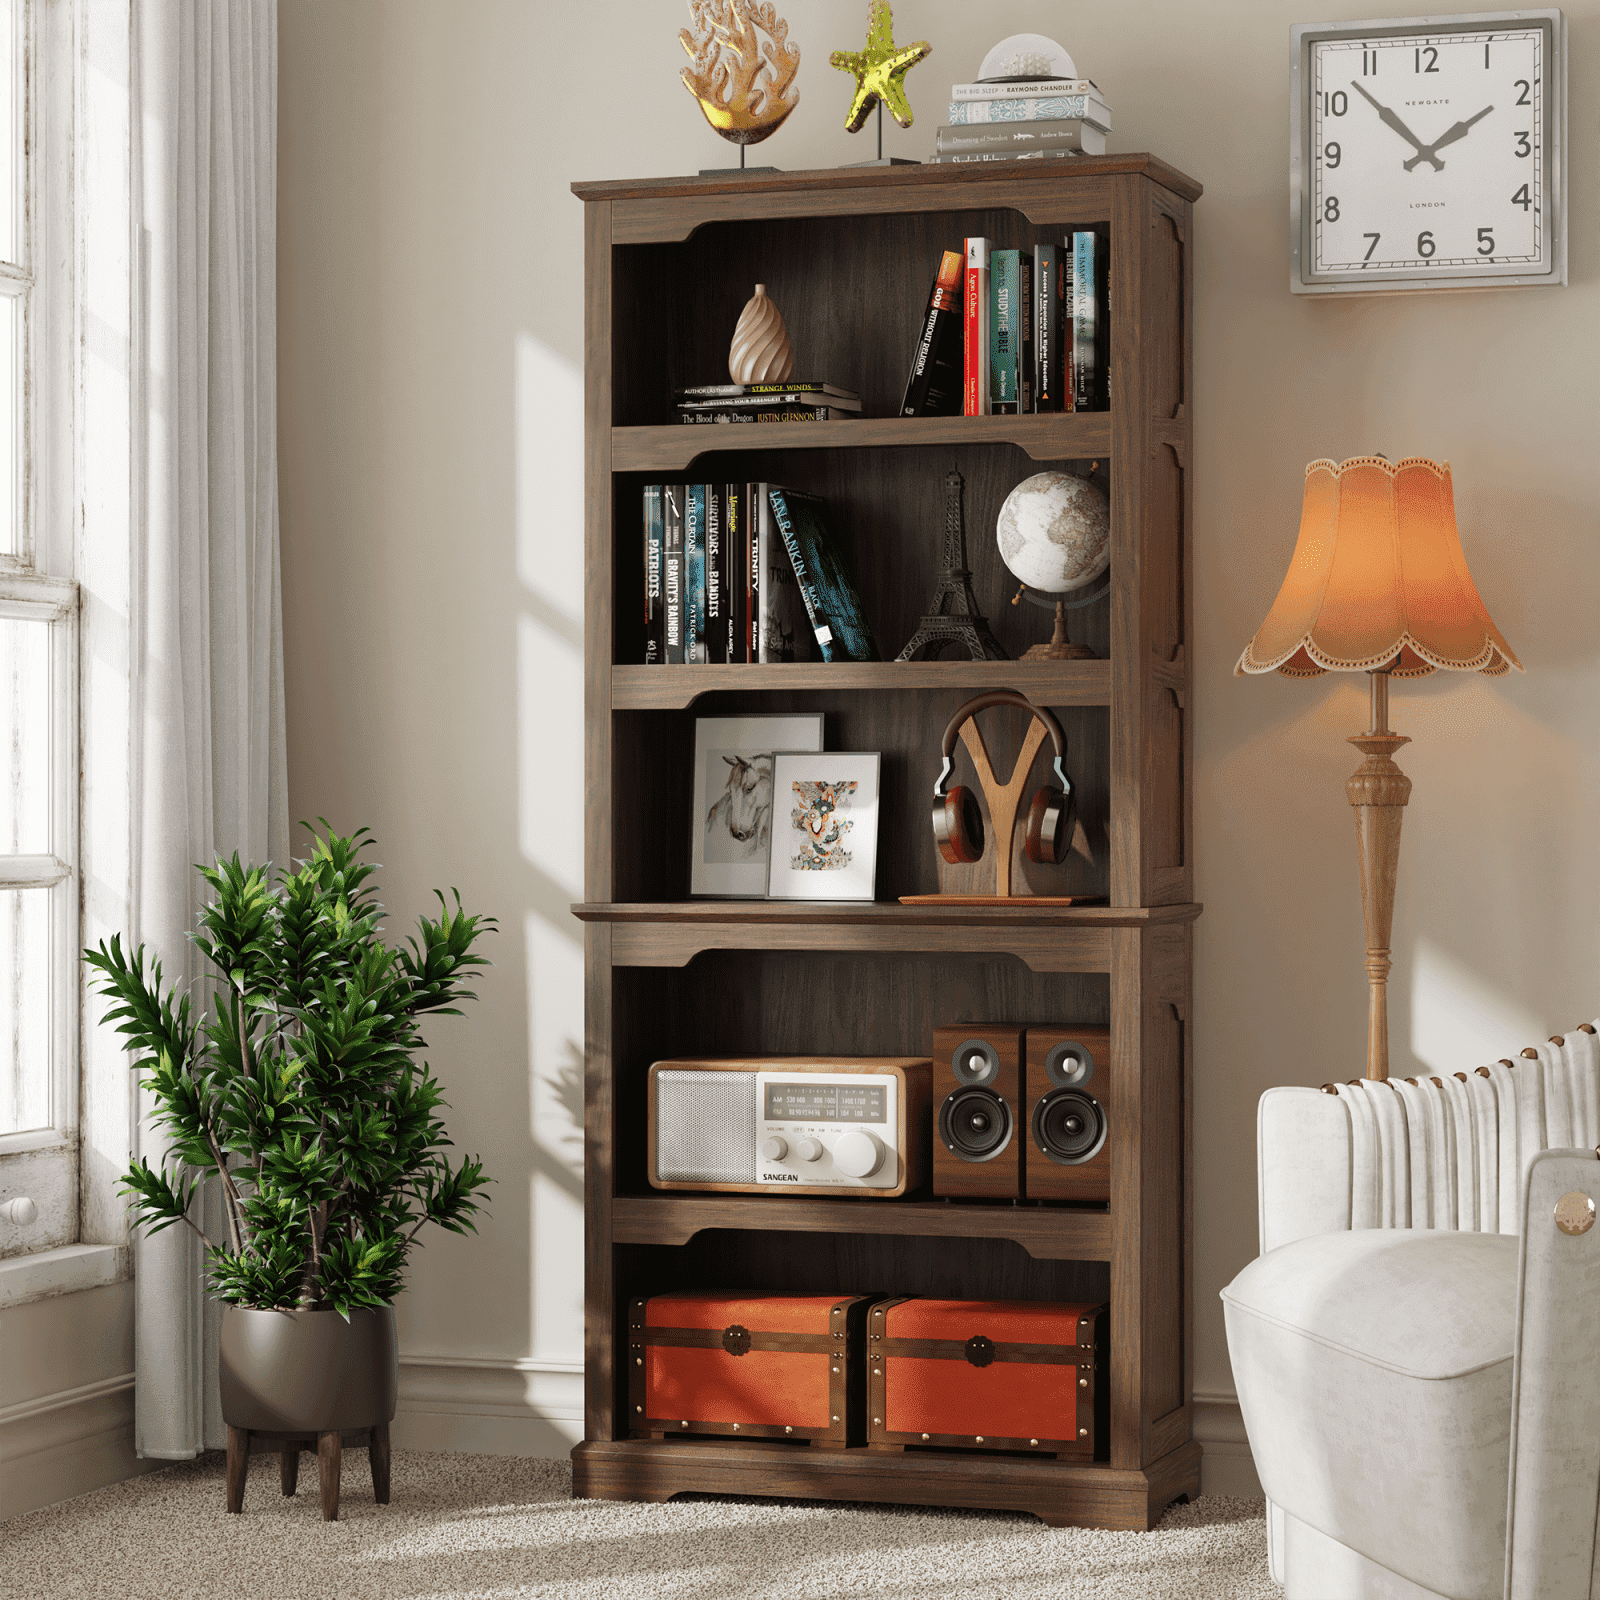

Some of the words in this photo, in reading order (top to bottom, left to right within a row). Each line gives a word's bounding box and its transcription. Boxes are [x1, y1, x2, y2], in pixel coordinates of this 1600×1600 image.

[1364, 50, 1376, 76] 11
[1415, 47, 1440, 73] 12
[1484, 44, 1490, 69] 1
[1324, 91, 1348, 117] 10
[1514, 80, 1531, 105] 2
[1324, 142, 1341, 169] 9
[1514, 131, 1531, 158] 3
[1324, 196, 1340, 222] 8
[1510, 184, 1532, 211] 4
[1363, 232, 1381, 260] 7
[1417, 231, 1436, 258] 6
[1476, 228, 1495, 255] 5
[933, 288, 943, 308] GOD
[924, 309, 939, 341] WITHOUT
[916, 342, 929, 376] RELIGION
[682, 414, 694, 423] The
[696, 413, 712, 423] Blood
[714, 413, 720, 423] of
[720, 413, 730, 423] the
[732, 413, 753, 423] Dragon
[758, 413, 779, 423] JUSTIN
[781, 412, 815, 422] GLENNON
[709, 494, 718, 554] SURVIVORS
[729, 496, 737, 532] Marriage
[769, 490, 788, 516] IAN
[780, 520, 807, 577] RANKIN
[649, 539, 659, 598] PATRIOTS
[668, 559, 678, 603] GRAVITY'S
[709, 571, 718, 617] BANDITS
[800, 585, 809, 602] AND
[808, 585, 820, 610] BLACK
[668, 605, 678, 646] RAINBOW
